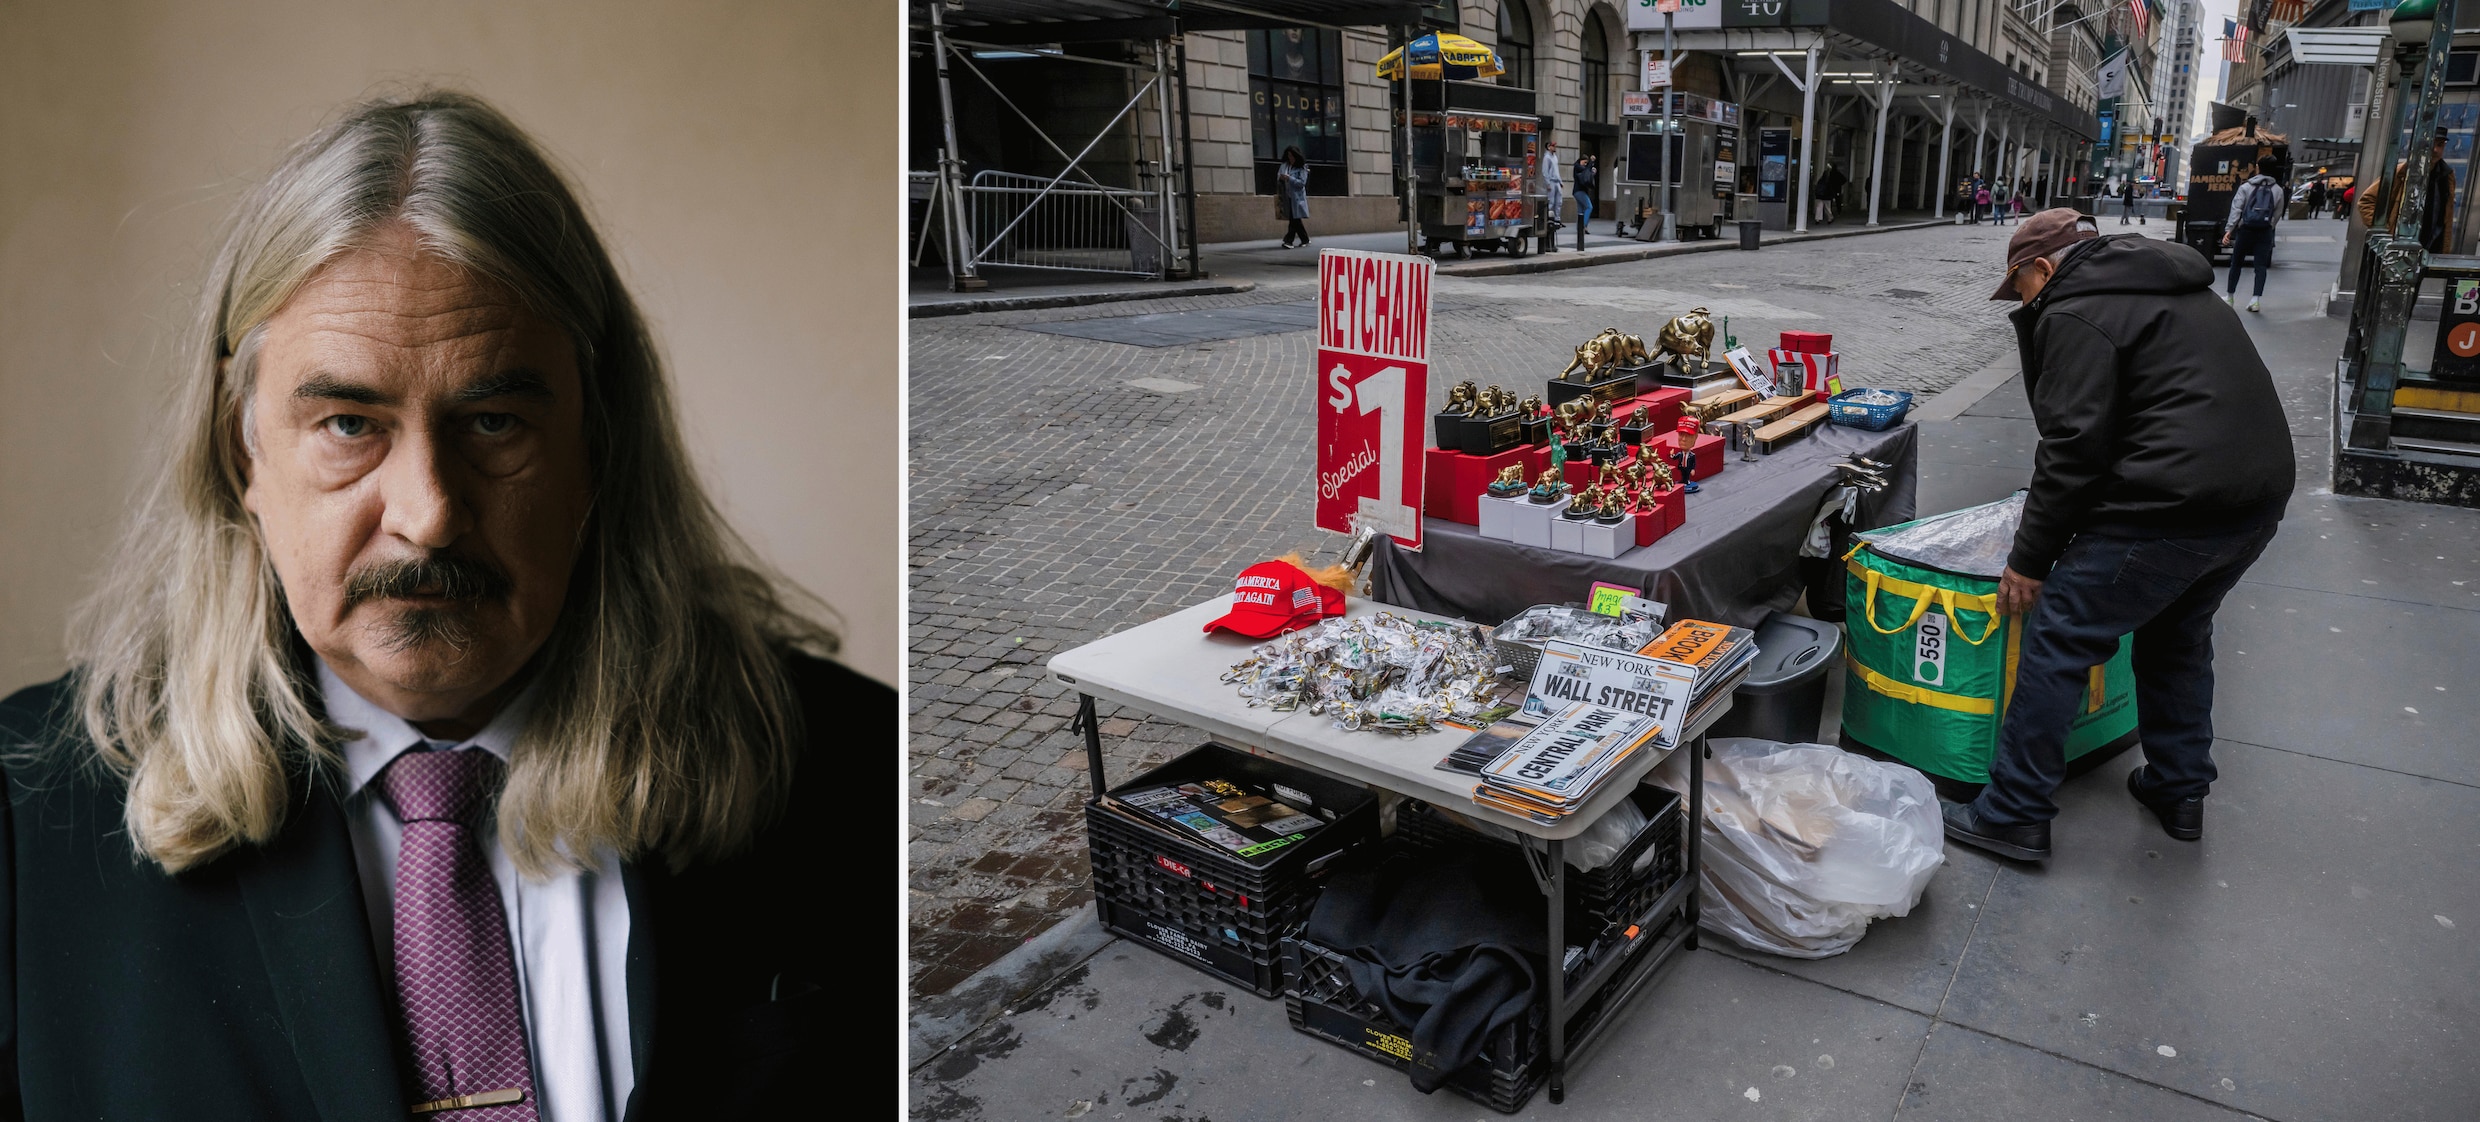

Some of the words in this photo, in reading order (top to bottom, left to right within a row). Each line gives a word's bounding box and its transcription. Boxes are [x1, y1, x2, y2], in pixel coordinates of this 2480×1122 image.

[1443, 51, 1489, 63] SABRETT
[2371, 57, 2391, 119] Newsstand
[1255, 91, 1336, 114] GOLDEN
[2191, 174, 2237, 184] JAMROCK
[2207, 182, 2233, 192] JERK
[1321, 254, 1430, 360] KEYCHAIN
[2458, 330, 2477, 350] J
[1245, 576, 1281, 591] AMERICA
[1245, 591, 1276, 606] AGAIN
[1661, 629, 1715, 662] BROOK
[1920, 624, 1941, 660] 550
[1580, 652, 1614, 668] NEW
[1614, 659, 1655, 677] YORK
[1543, 673, 1592, 703] WALL
[1597, 685, 1674, 721] STREET
[1515, 736, 1541, 755] NEW
[1536, 717, 1568, 736] YORK
[1517, 736, 1585, 780] CENTRAL
[1574, 708, 1620, 733] PARK
[1163, 858, 1192, 878] DIE-CA
[1146, 921, 1169, 935] CLOVER
[1189, 939, 1208, 951] DAIRY
[1365, 1027, 1392, 1041] CLOVER
